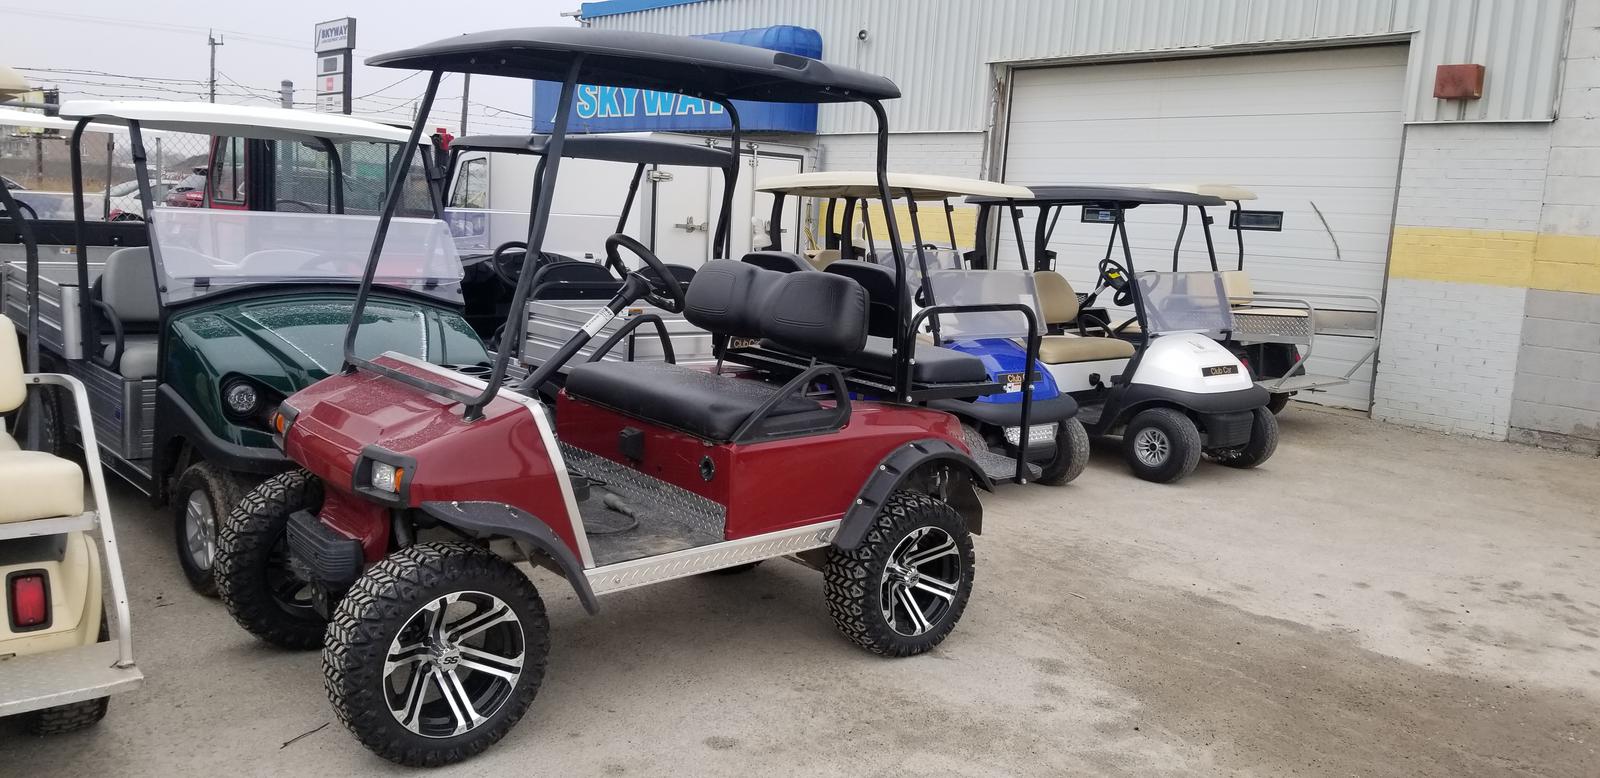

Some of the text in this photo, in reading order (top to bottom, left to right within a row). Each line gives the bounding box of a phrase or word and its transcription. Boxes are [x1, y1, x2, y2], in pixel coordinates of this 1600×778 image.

[321, 25, 348, 39] SKYWAY
[733, 339, 749, 348] Club
[1210, 366, 1232, 375] Club Car
[1007, 373, 1022, 383] Club
[443, 655, 460, 665] SS
